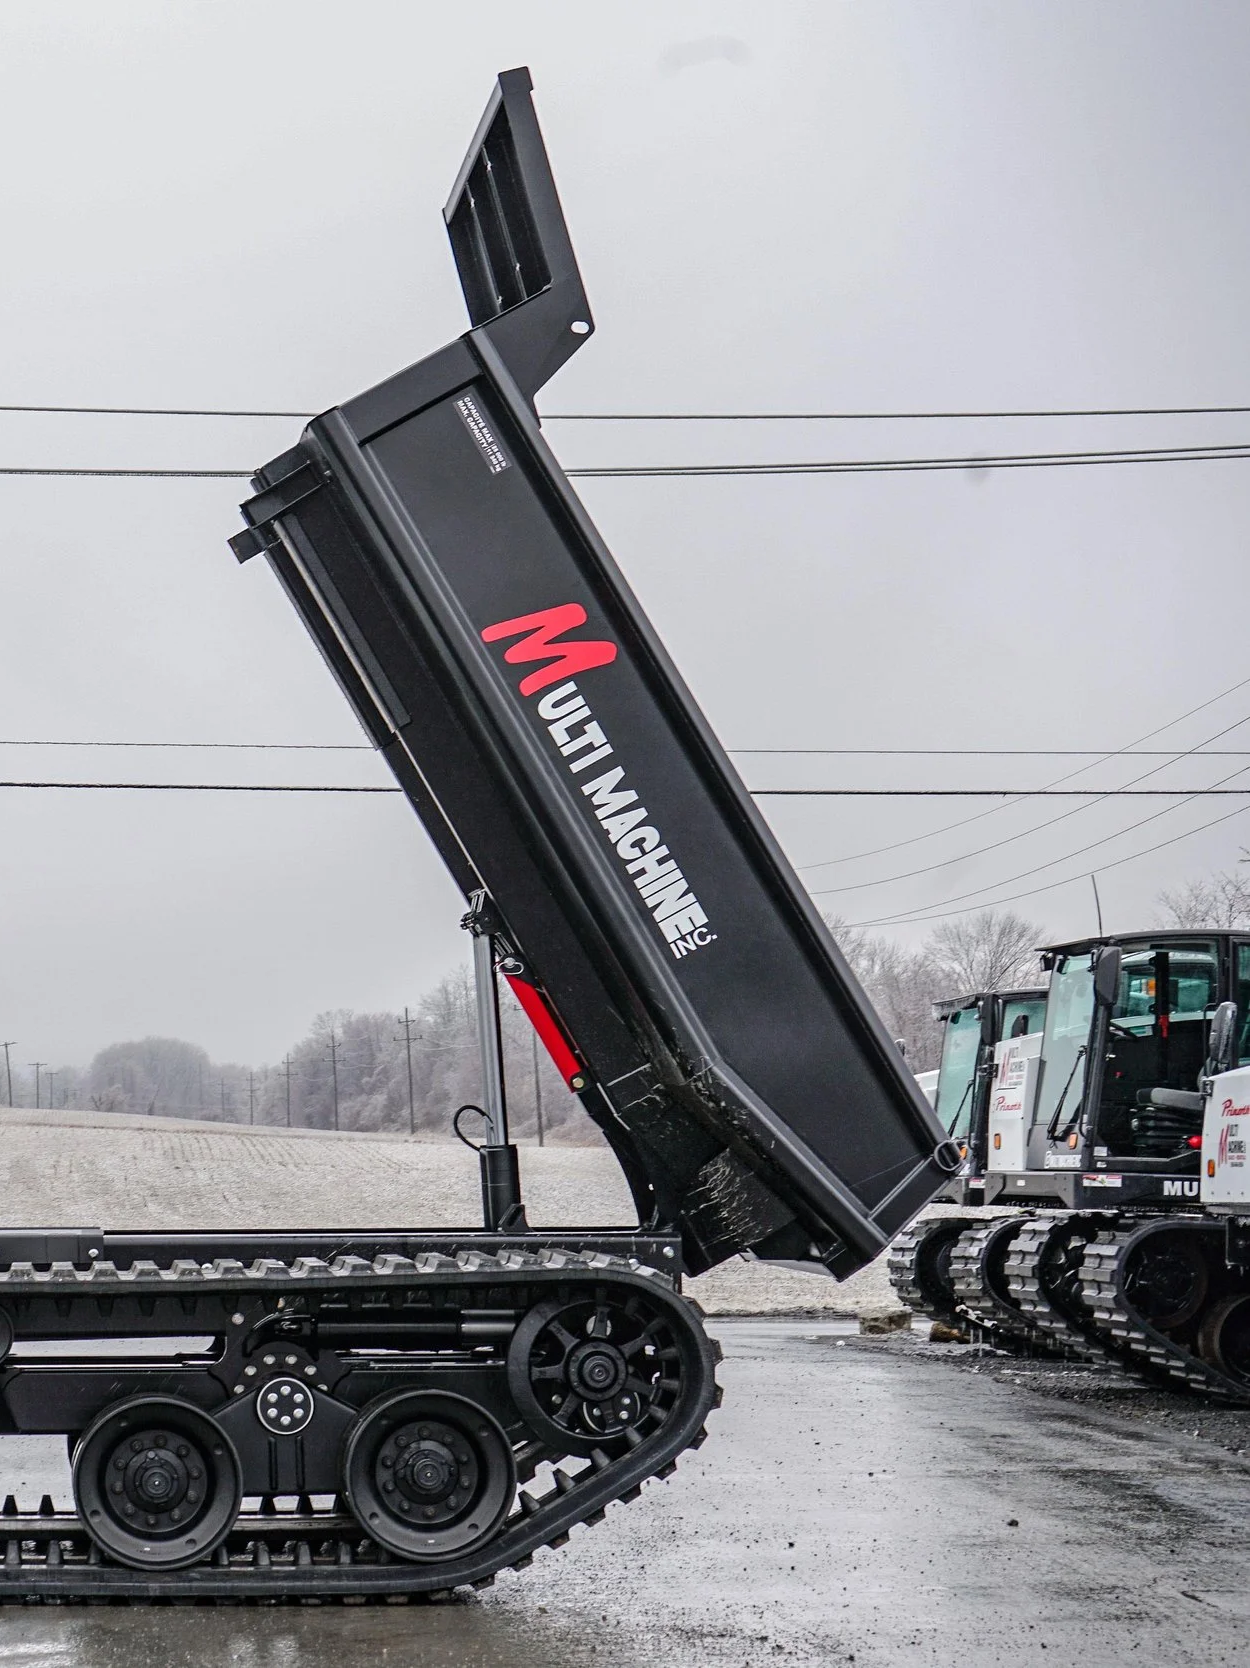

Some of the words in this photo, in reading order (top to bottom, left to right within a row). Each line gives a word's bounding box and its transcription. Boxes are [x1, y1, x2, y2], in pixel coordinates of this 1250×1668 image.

[463, 396, 486, 429] CAPACITÉ
[481, 427, 494, 443] MAX
[466, 417, 488, 448] CAPACITY
[581, 766, 709, 943] MACHINE
[669, 927, 718, 960] INC.
